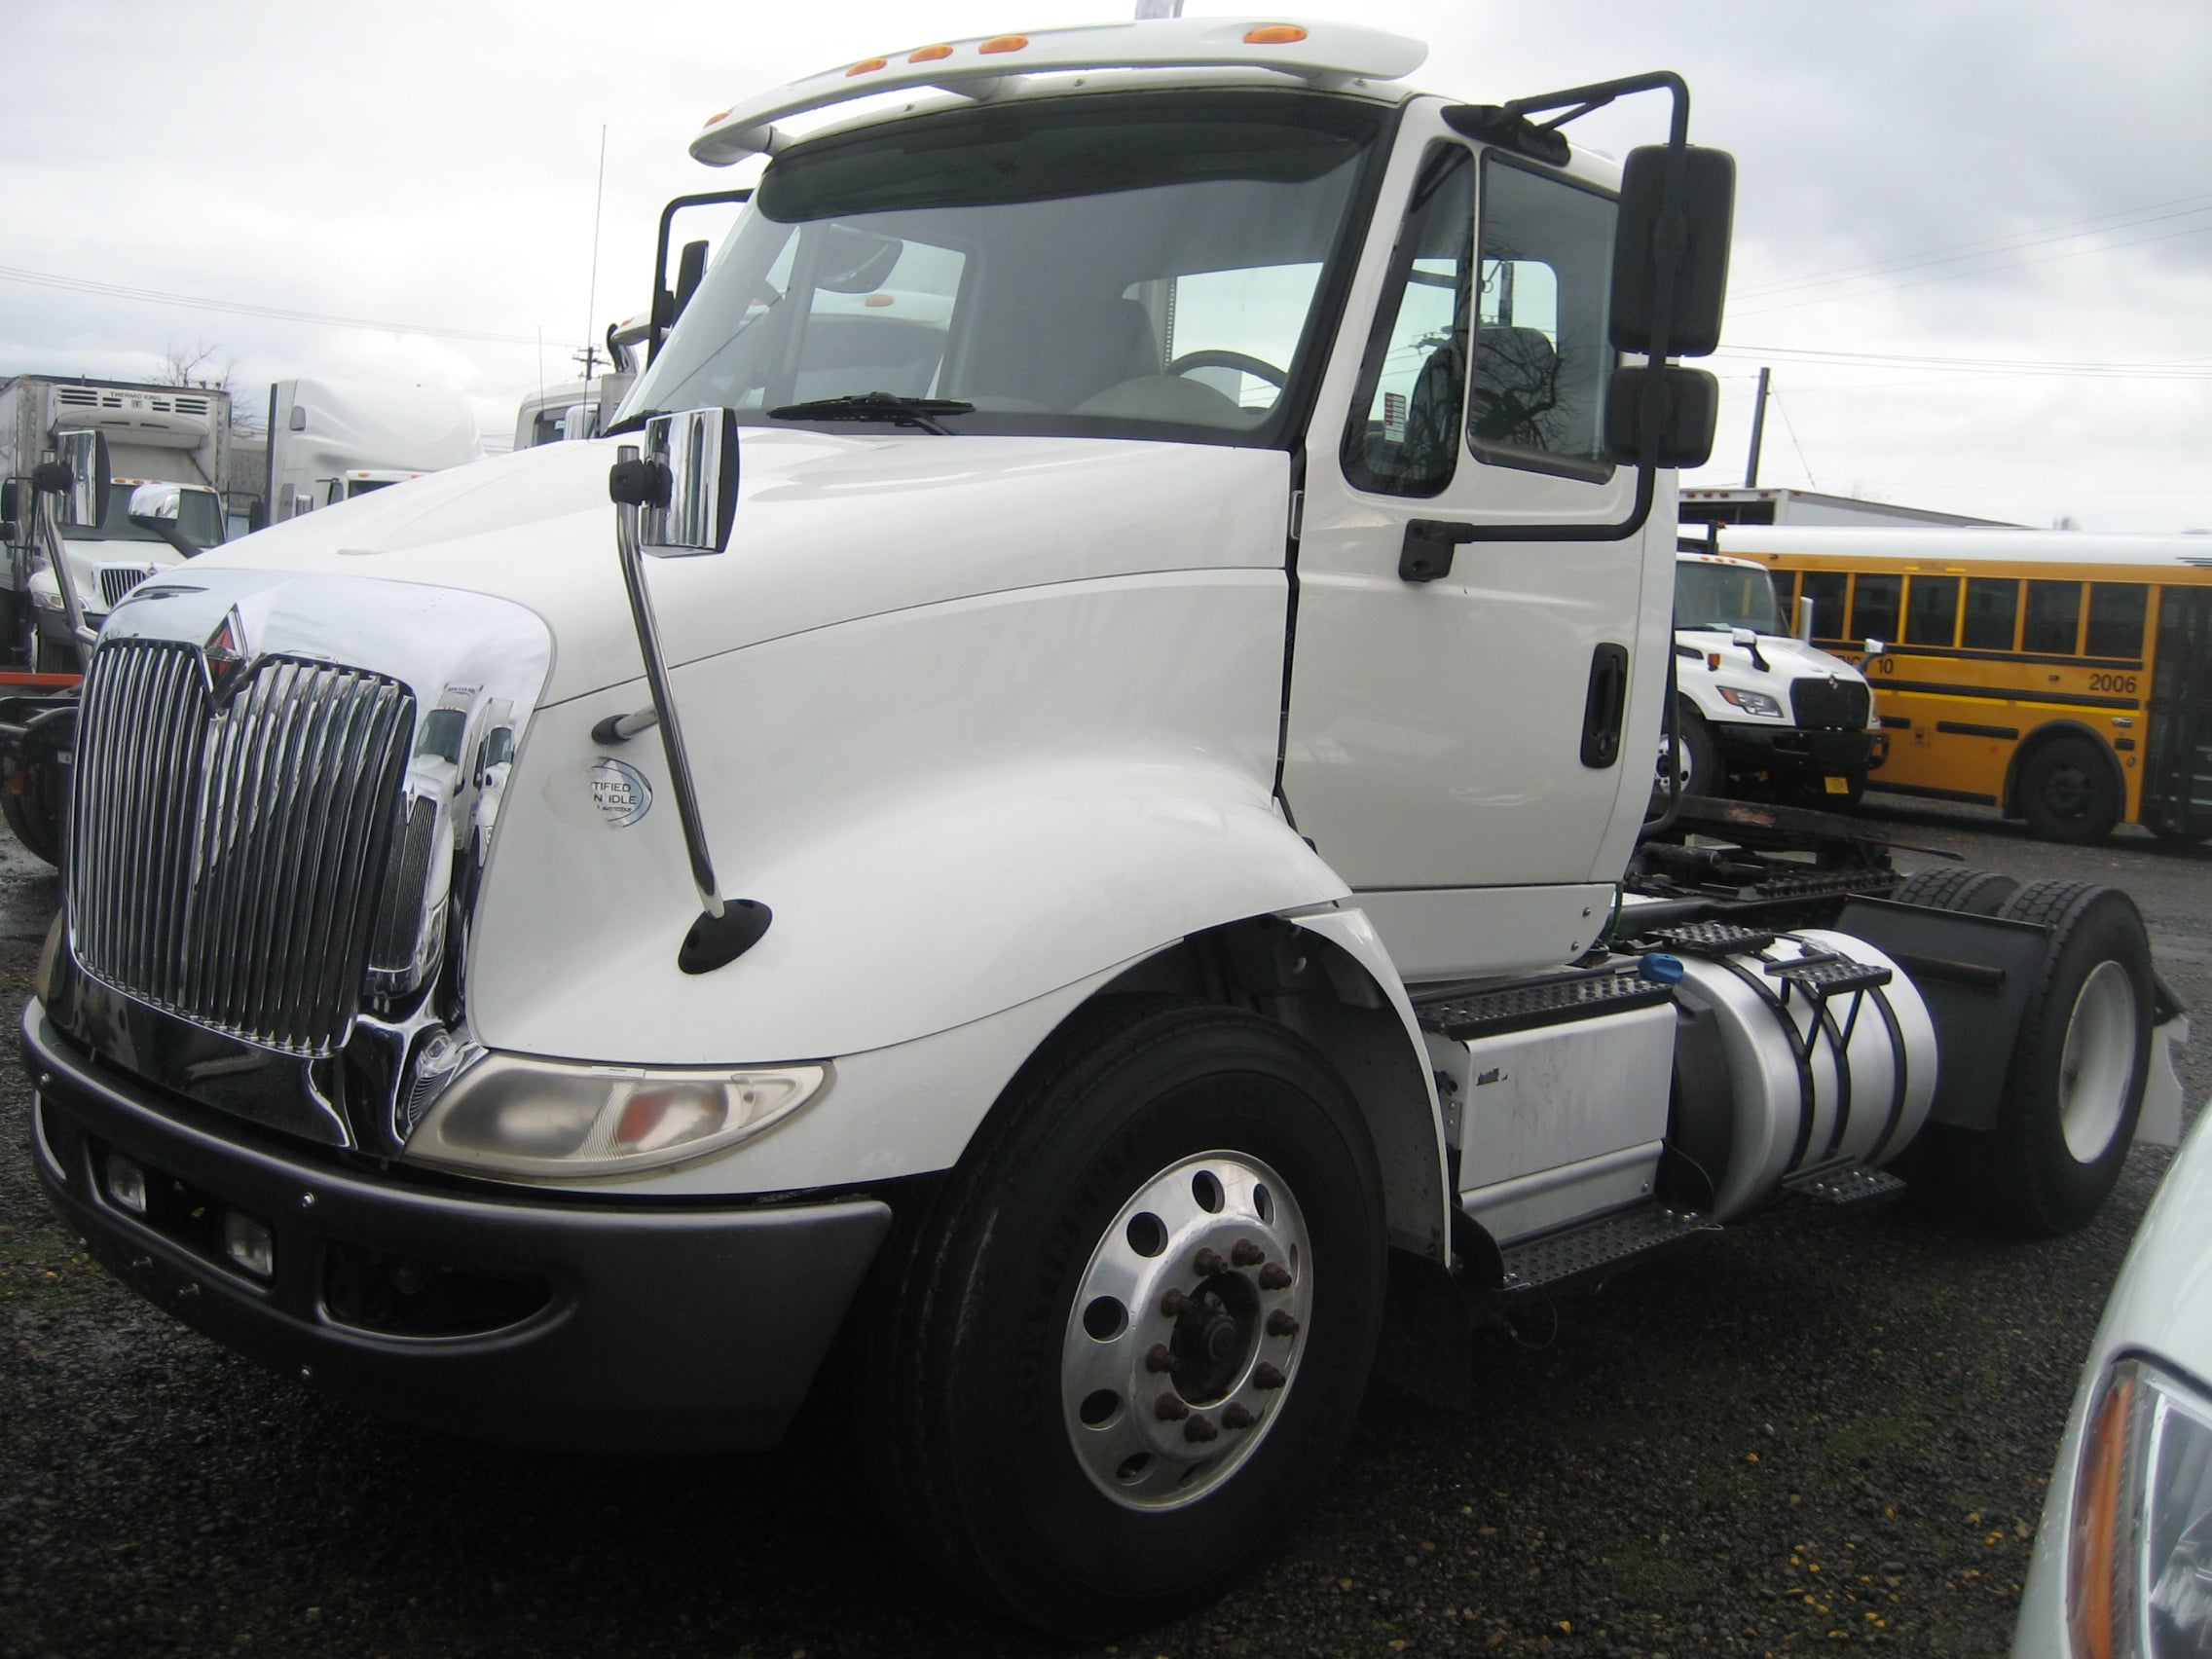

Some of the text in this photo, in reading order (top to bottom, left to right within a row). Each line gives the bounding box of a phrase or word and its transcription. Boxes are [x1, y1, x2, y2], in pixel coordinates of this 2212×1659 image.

[1876, 658, 1894, 675] 10
[2088, 673, 2136, 694] 2006
[608, 794, 637, 805] IDLE
